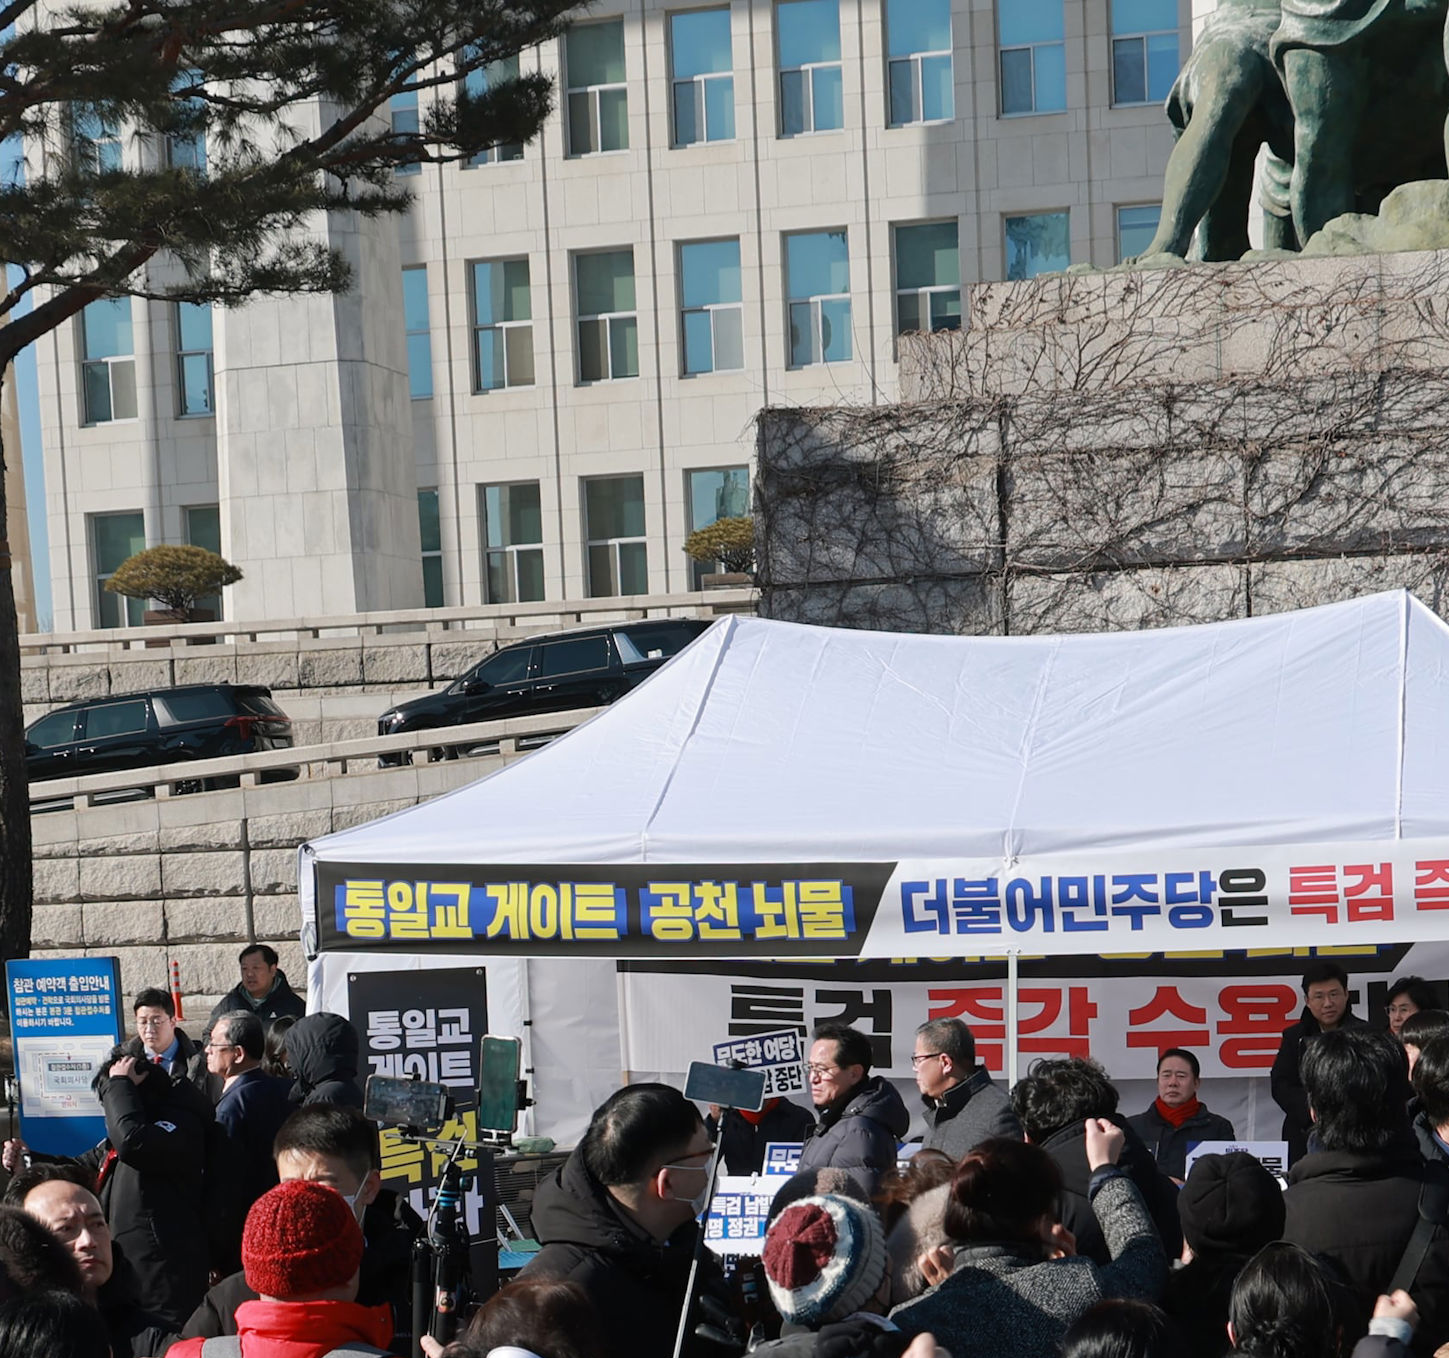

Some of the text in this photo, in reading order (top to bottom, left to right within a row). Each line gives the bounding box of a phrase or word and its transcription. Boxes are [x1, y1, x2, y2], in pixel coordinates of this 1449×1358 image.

[344, 879, 474, 940] 통일교
[486, 881, 619, 940] 게이트
[649, 880, 741, 941] 공천
[753, 880, 846, 940] 뇌물
[901, 867, 1269, 935] 더불어민주당은
[1288, 861, 1394, 924] 특검
[13, 975, 110, 993] 참관 예약객 출입안내
[366, 1008, 474, 1050] 통일교
[728, 984, 893, 1070] 특검
[927, 986, 1098, 1072] 즉각
[763, 1035, 796, 1062] 여당
[367, 1051, 475, 1088] 게이트
[775, 1064, 803, 1092] 중단
[768, 1147, 801, 1173] 무도
[711, 1195, 742, 1216] 특검
[727, 1216, 758, 1238] 정권
